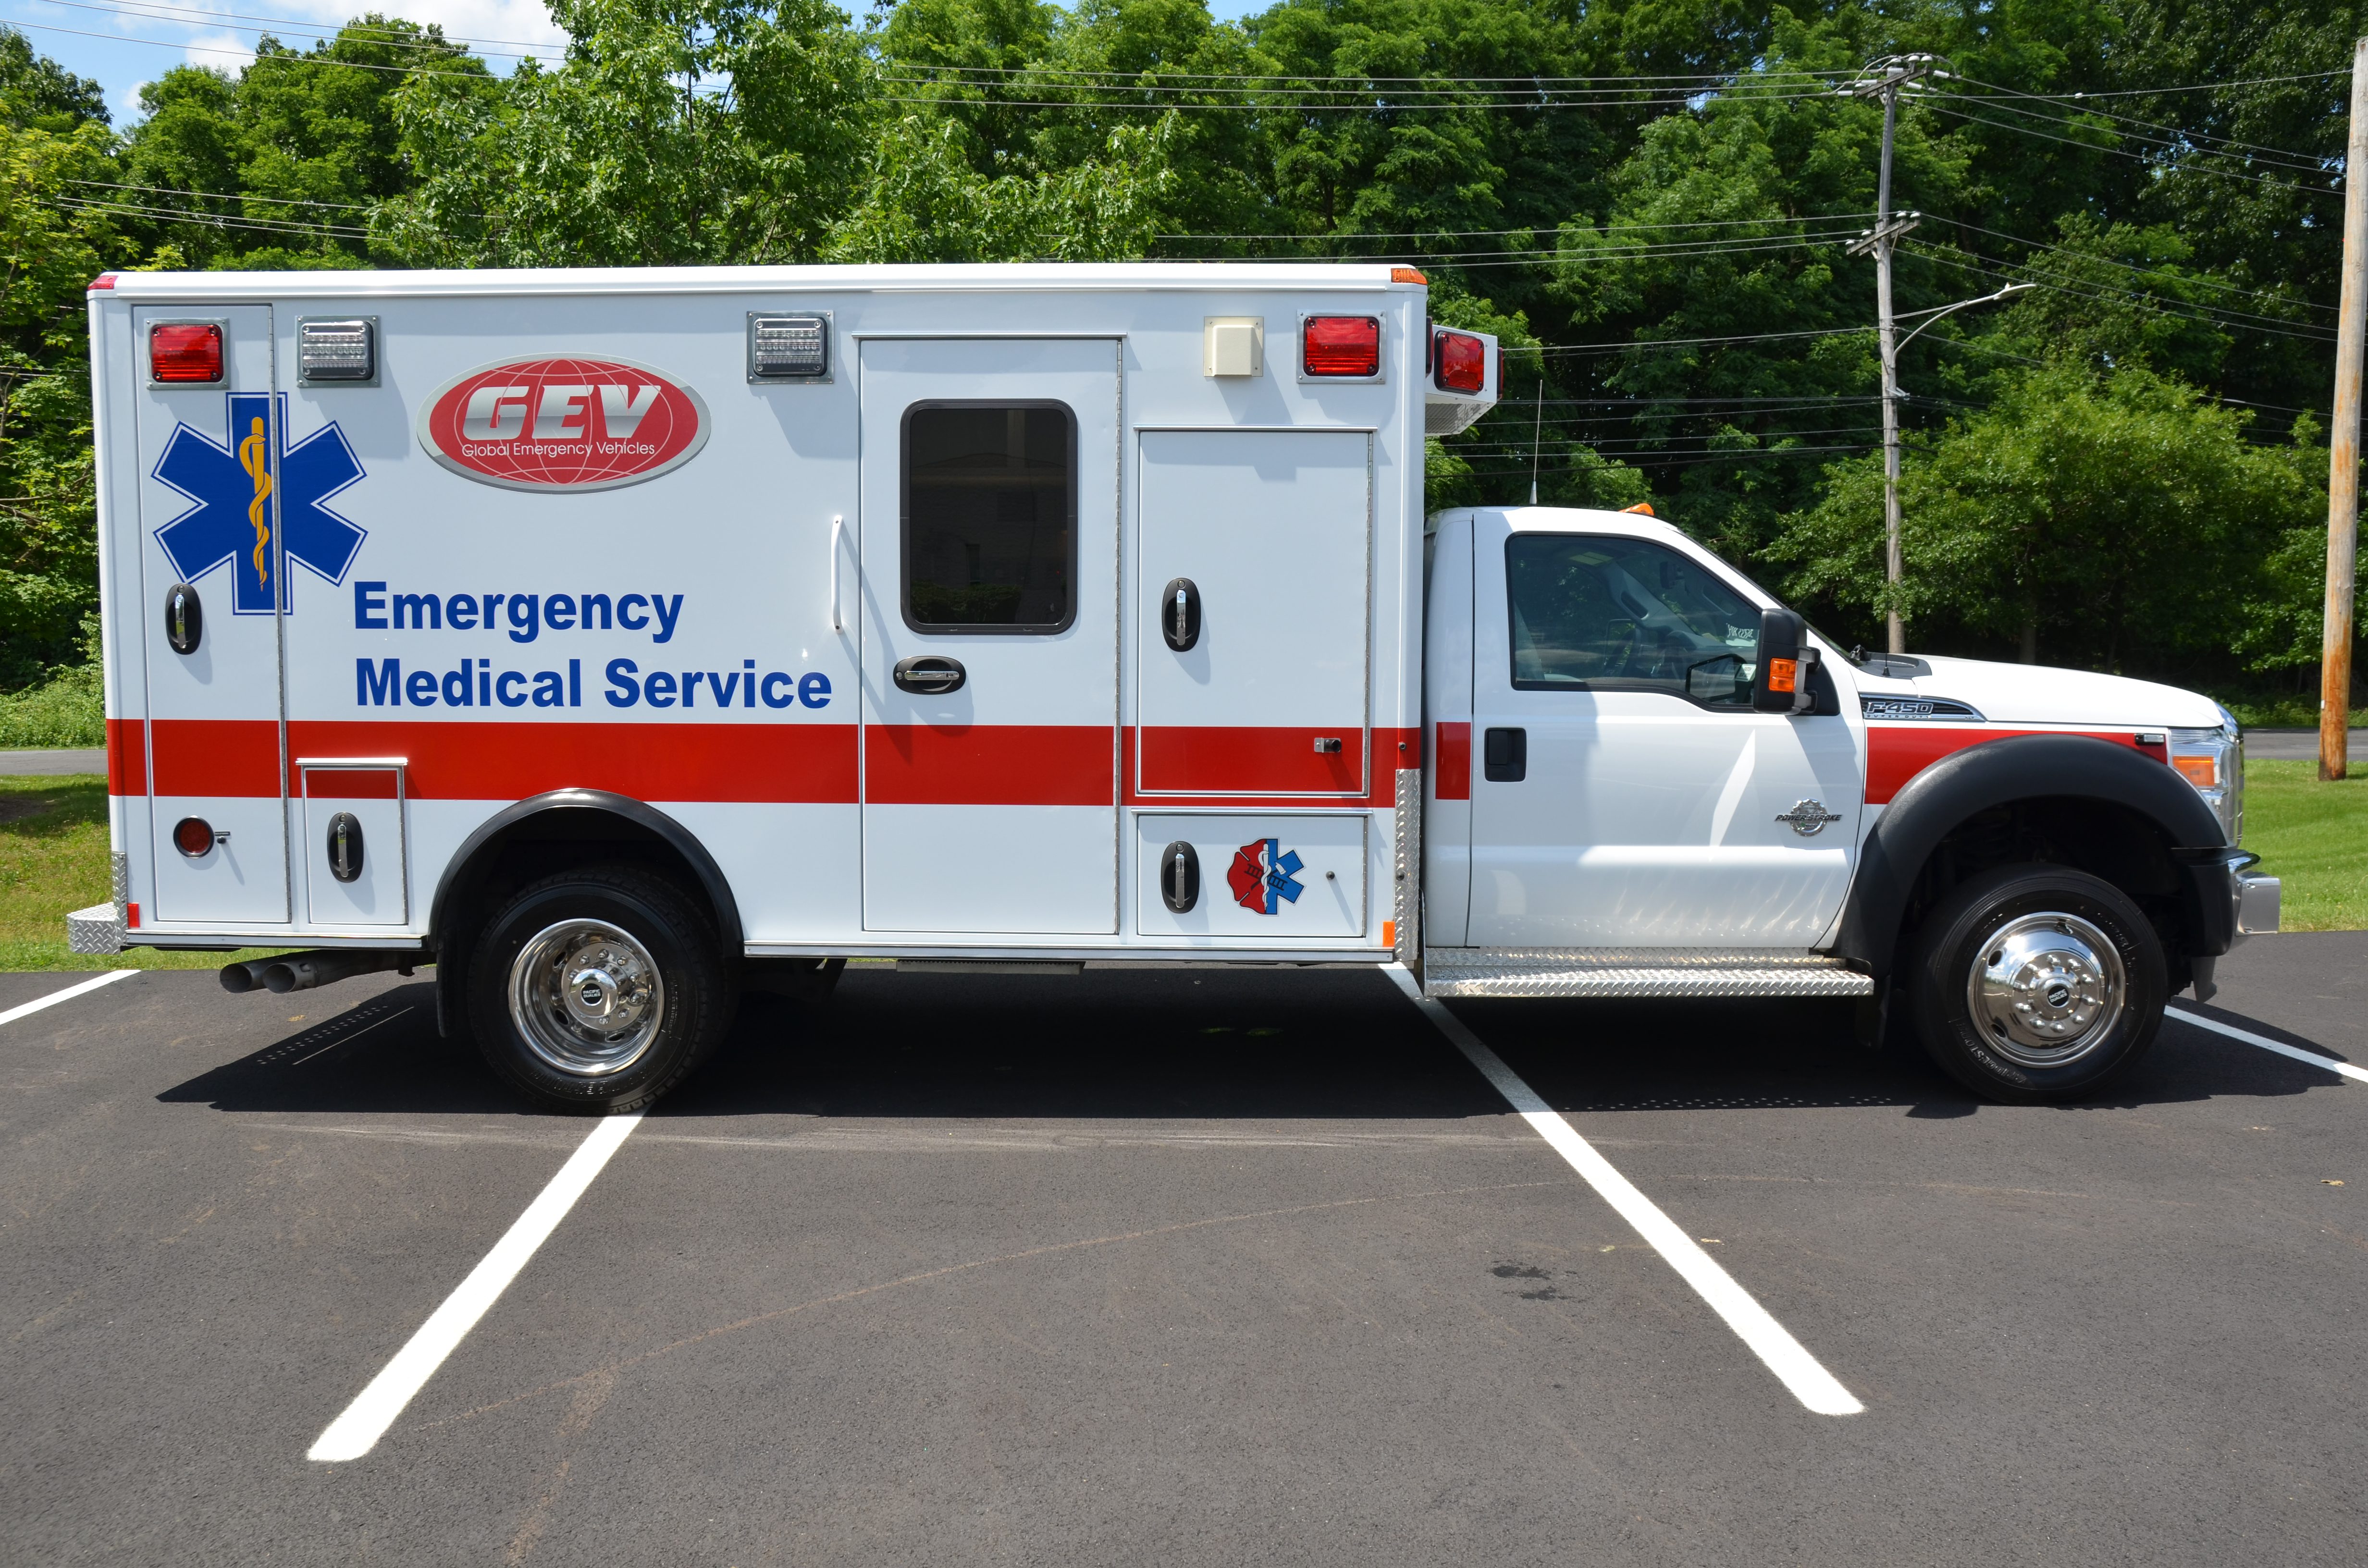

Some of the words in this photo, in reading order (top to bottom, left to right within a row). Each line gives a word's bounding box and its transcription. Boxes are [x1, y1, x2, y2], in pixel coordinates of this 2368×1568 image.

[463, 385, 661, 441] GEV
[462, 443, 509, 456] Global
[513, 442, 593, 457] Emergency
[596, 441, 655, 455] Vehicles
[355, 581, 684, 643] Emergency
[357, 658, 581, 707] Medical
[605, 658, 832, 709] Service
[1866, 701, 1934, 714] F-450
[2048, 989, 2066, 999] PACIFIC
